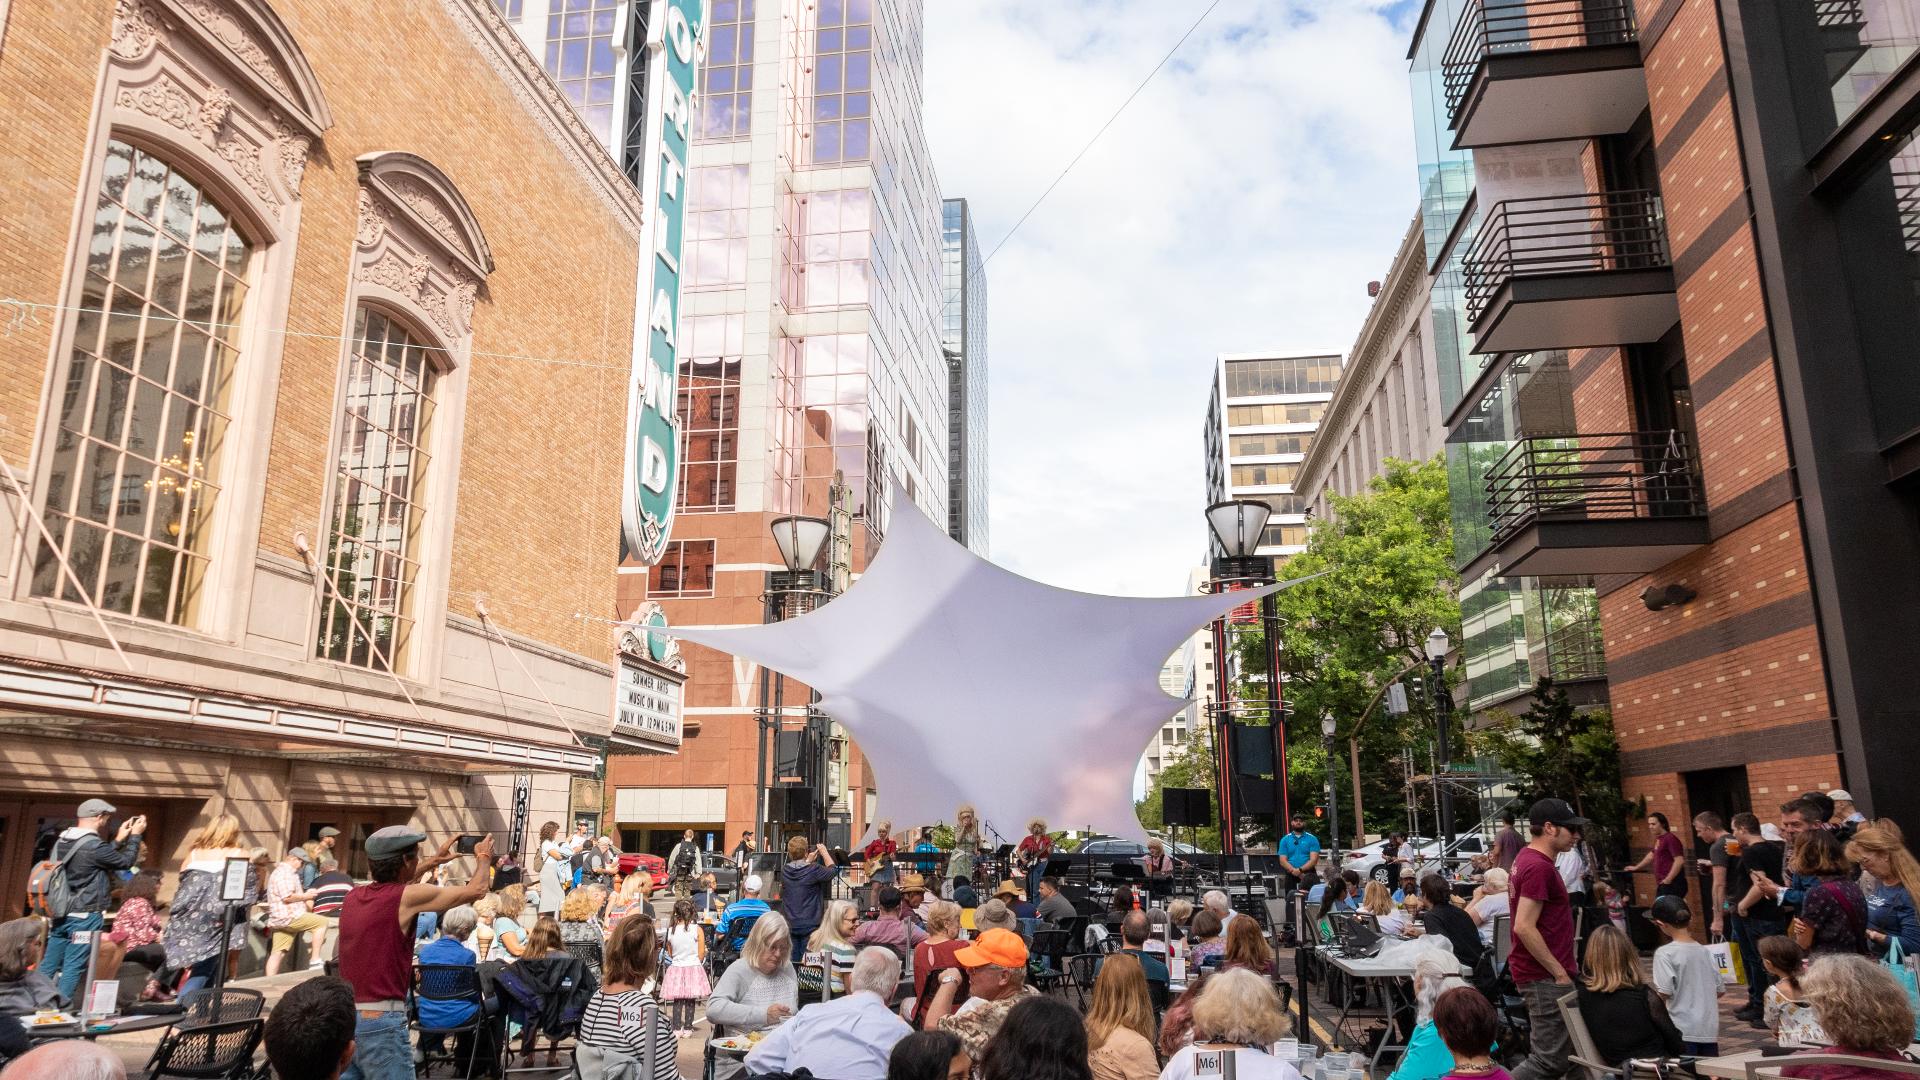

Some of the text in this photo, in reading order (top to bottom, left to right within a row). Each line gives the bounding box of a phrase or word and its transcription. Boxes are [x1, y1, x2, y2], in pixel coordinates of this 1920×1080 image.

[633, 672, 668, 694] SUMMER ARTS
[629, 691, 669, 714] MUSIC ON MAIN
[620, 710, 634, 725] JULY
[638, 713, 643, 726] 10
[620, 1011, 640, 1021] M62
[1199, 1057, 1218, 1069] M61
